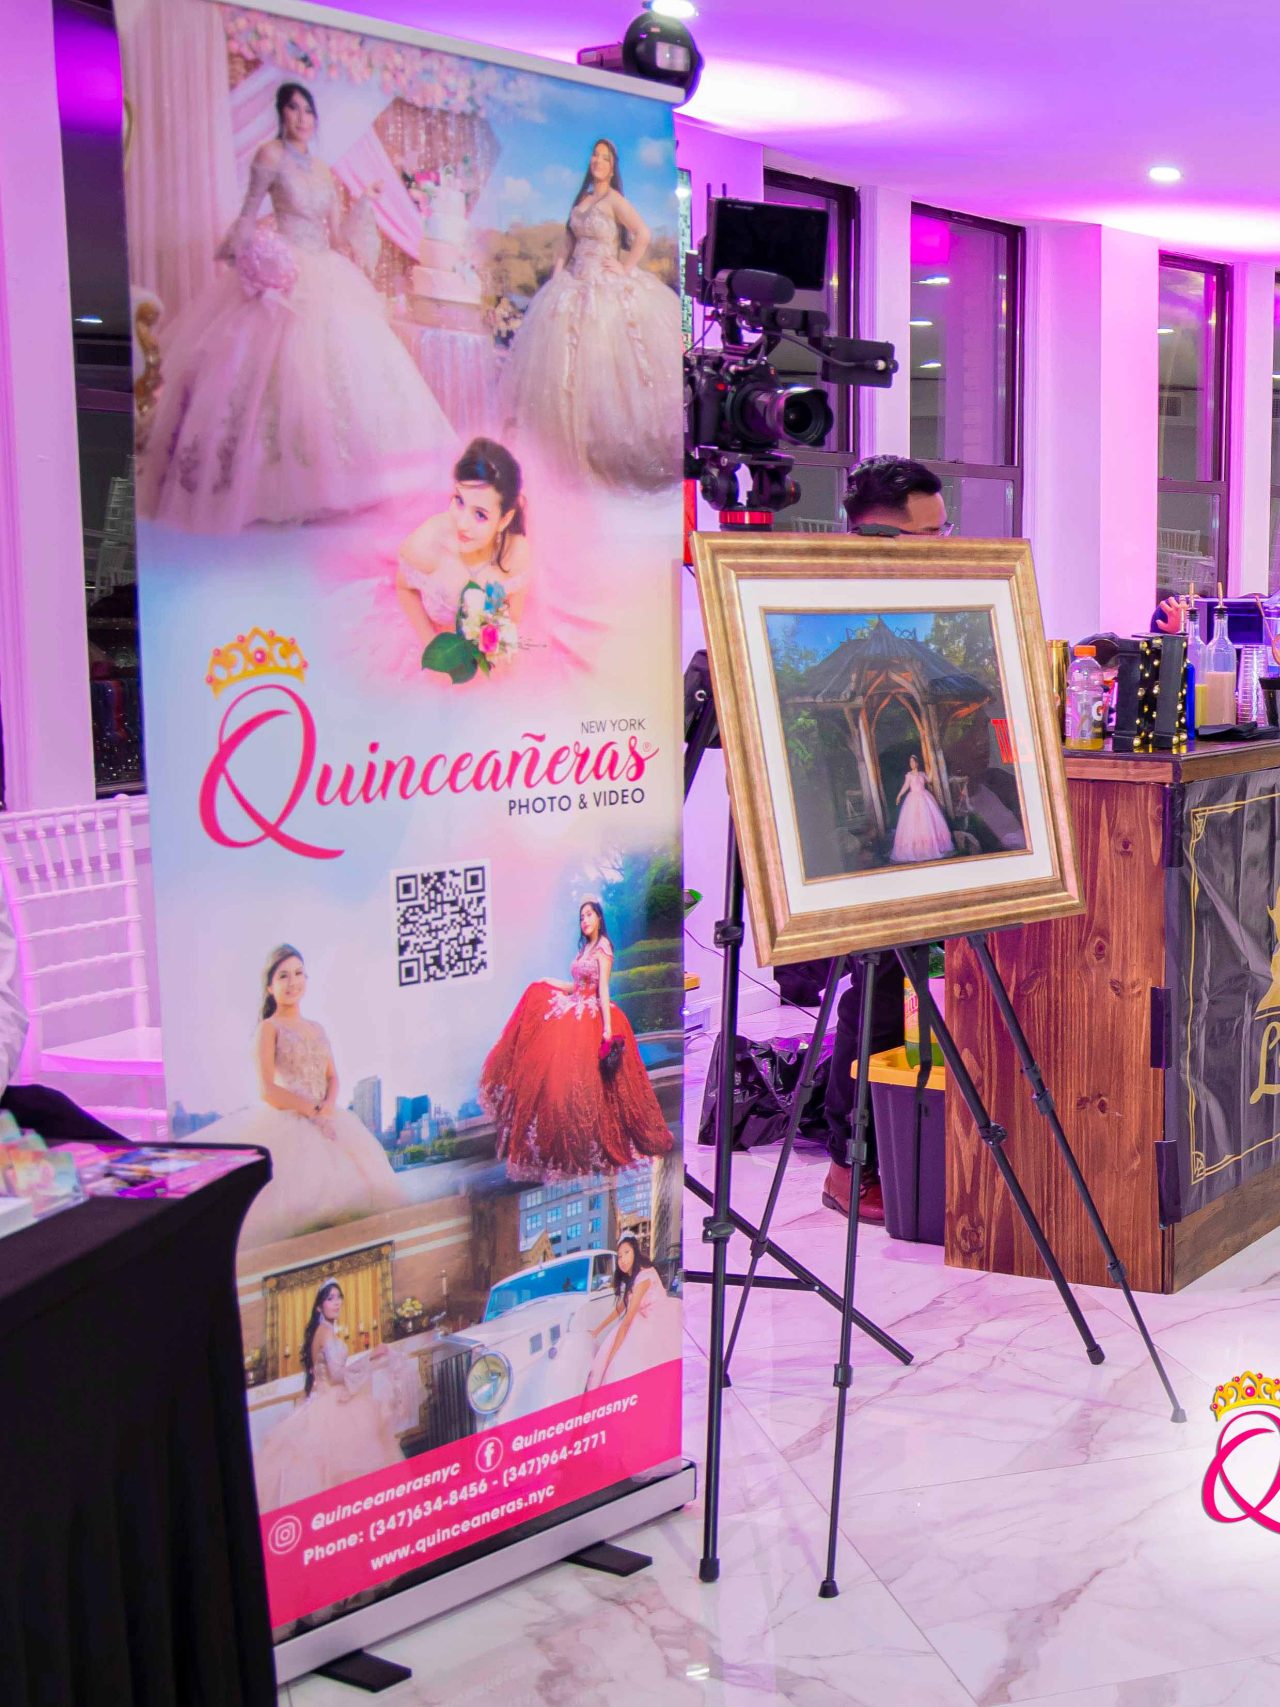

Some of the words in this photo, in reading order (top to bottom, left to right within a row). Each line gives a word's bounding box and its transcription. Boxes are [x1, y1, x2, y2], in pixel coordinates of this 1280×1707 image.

[580, 720, 606, 735] NEW
[609, 717, 646, 733] YORK
[508, 795, 572, 816] PHOTO
[578, 793, 590, 810] &
[593, 787, 646, 808] VIDEO
[511, 1393, 639, 1452] Quinceanerasnyc
[303, 1530, 364, 1565] Phone:
[369, 1478, 488, 1542] (347)634-8456
[503, 1430, 608, 1488] (347)964-2771
[310, 1460, 461, 1532] Quinceanerasnyc
[371, 1484, 555, 1571] www.quinceaneras.nyc
